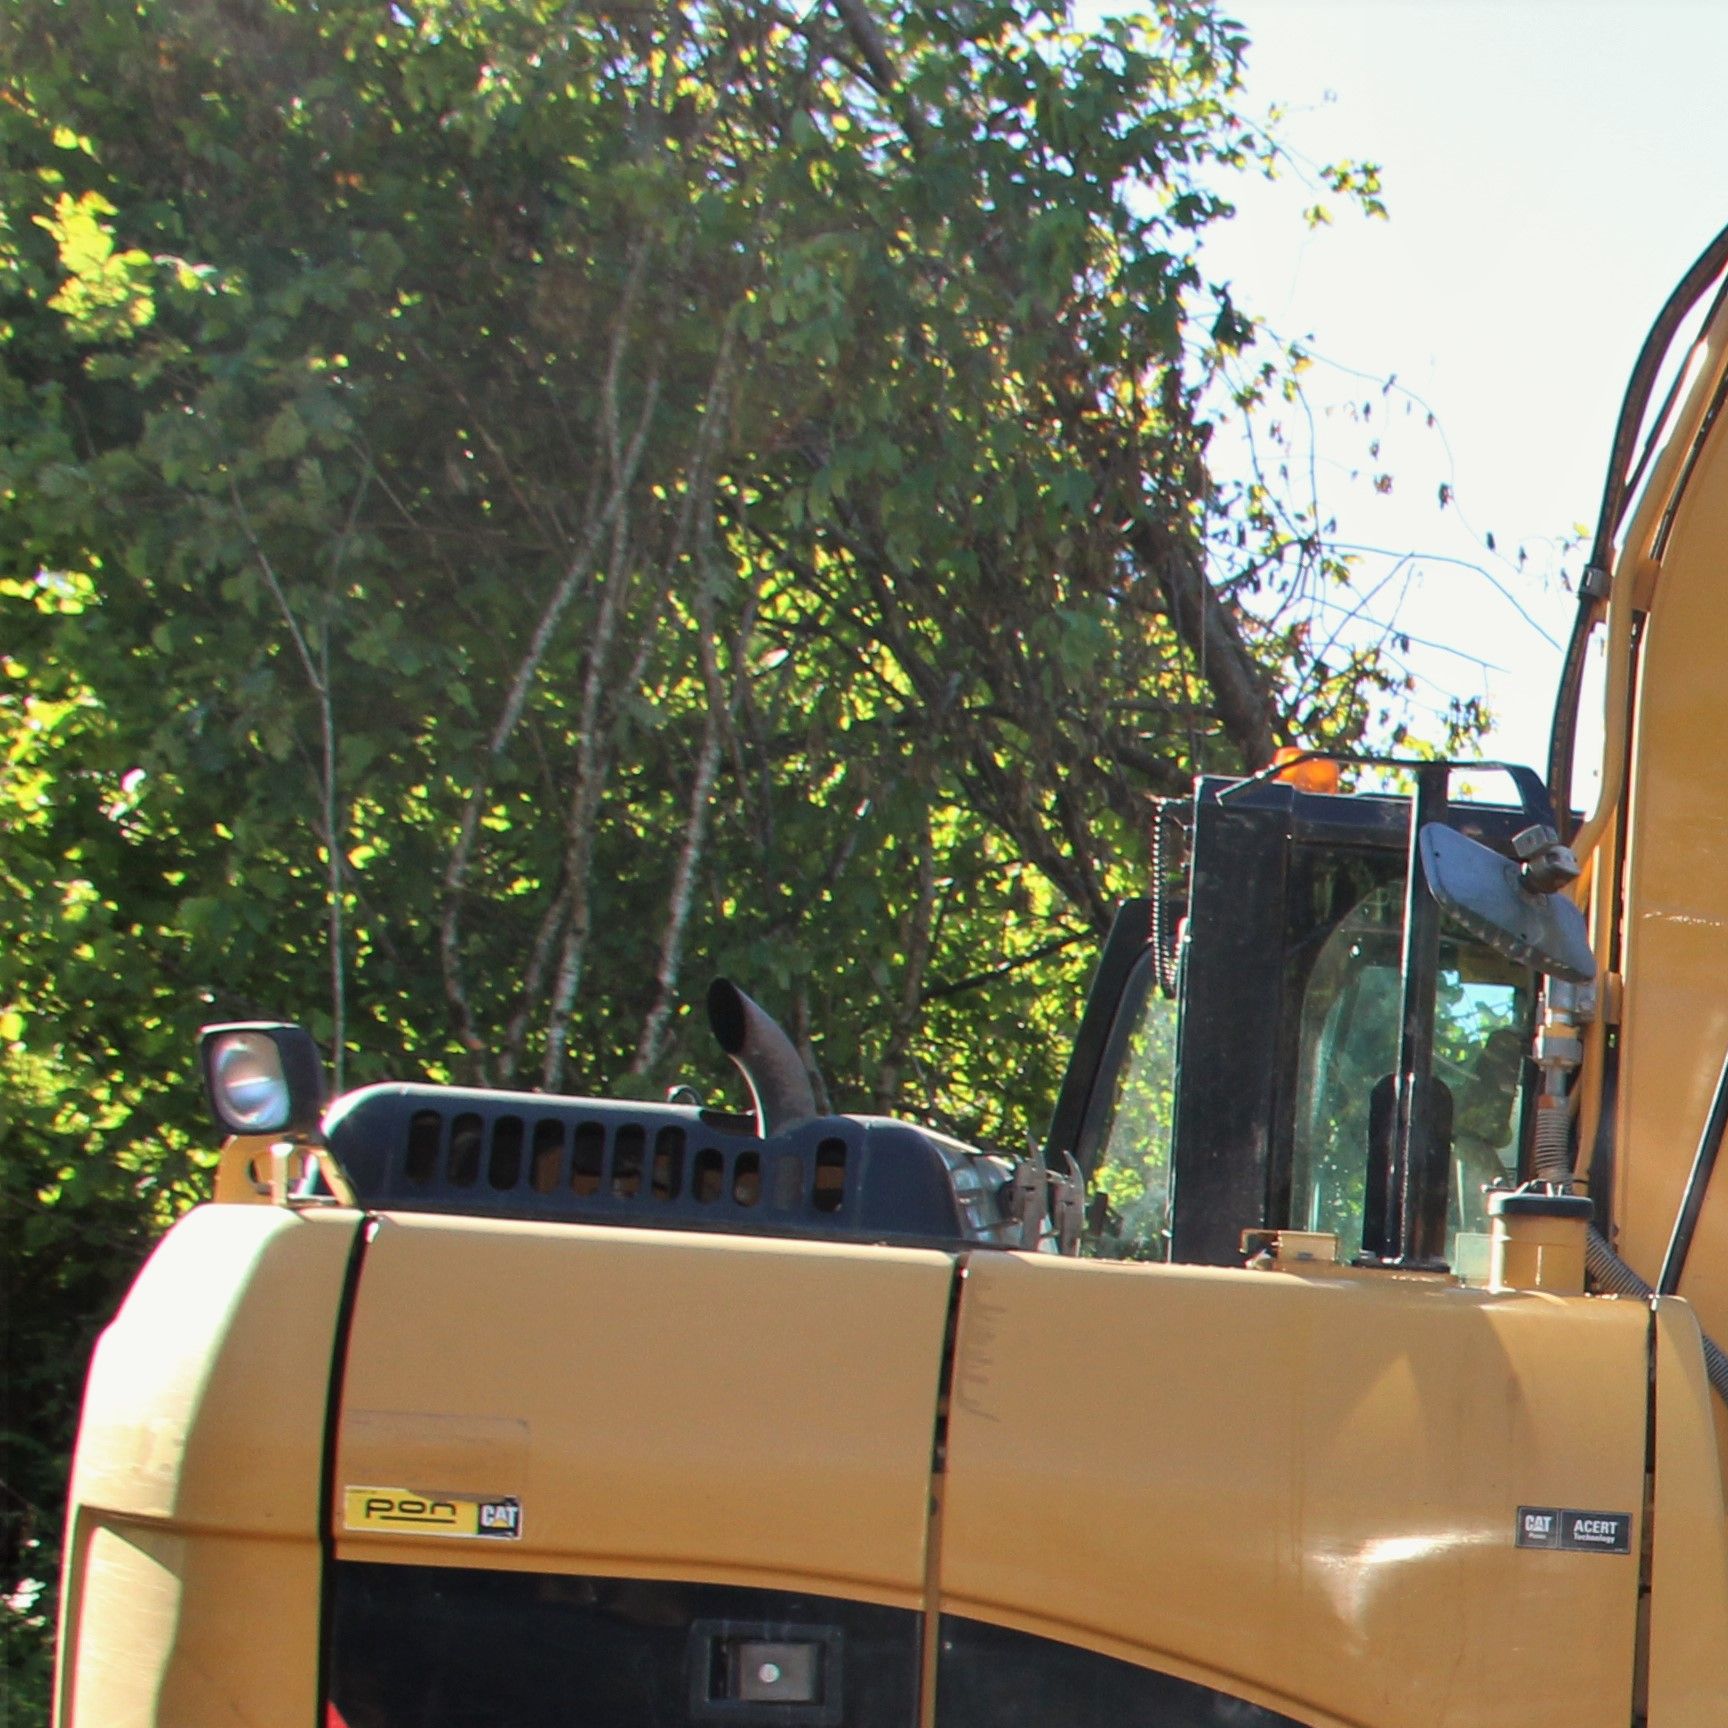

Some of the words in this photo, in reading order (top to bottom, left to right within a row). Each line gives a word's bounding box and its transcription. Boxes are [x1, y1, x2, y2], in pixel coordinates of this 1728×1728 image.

[365, 1498, 456, 1519] pon
[479, 1504, 518, 1529] CAT
[1524, 1514, 1552, 1533] CAT
[1573, 1519, 1618, 1535] ACERT
